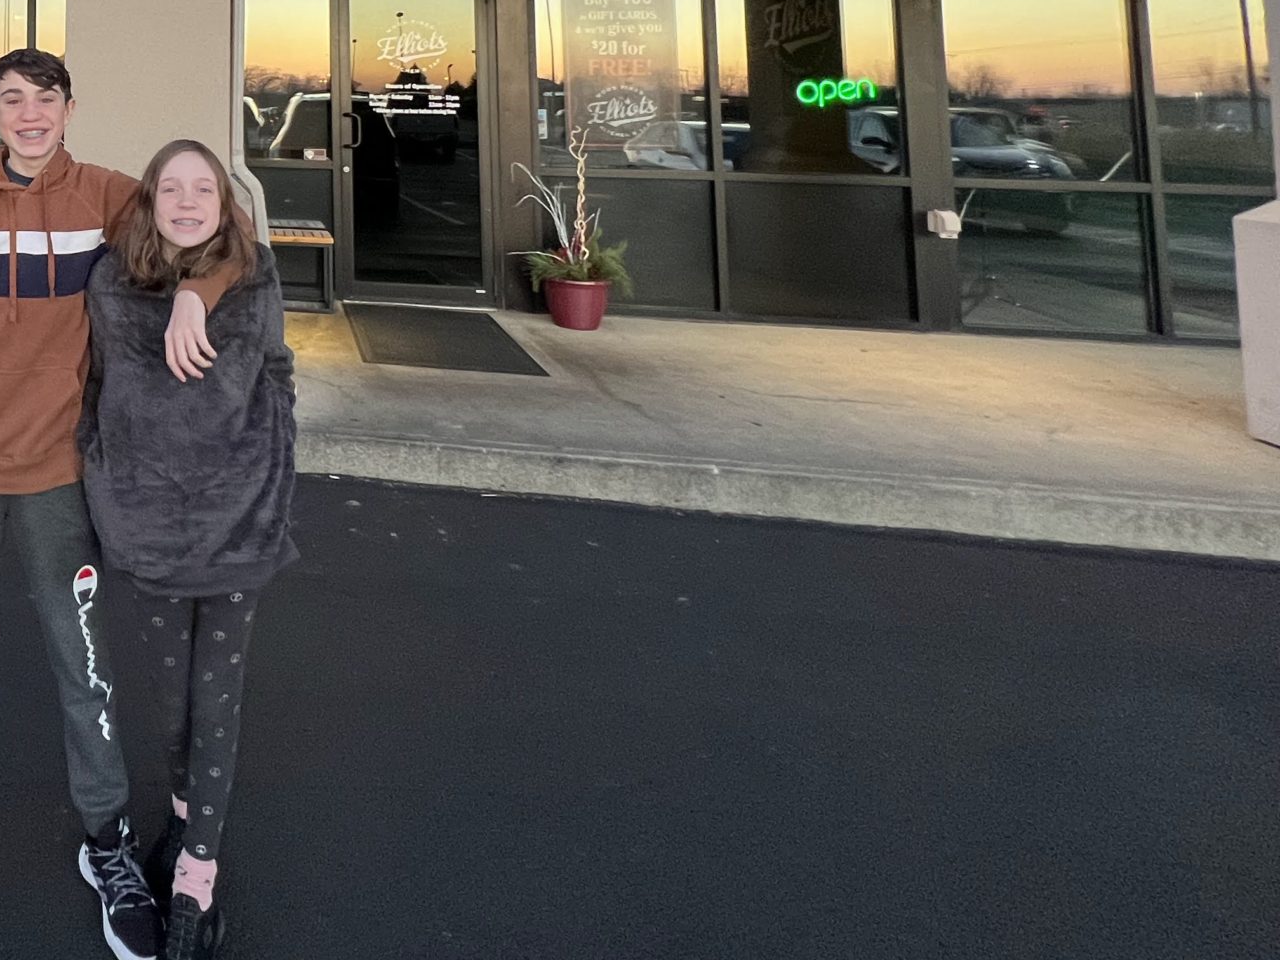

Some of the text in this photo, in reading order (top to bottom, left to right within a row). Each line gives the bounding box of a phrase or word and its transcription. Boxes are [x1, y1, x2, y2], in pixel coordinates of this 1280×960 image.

[588, 10, 614, 20] GIFT
[618, 9, 657, 20] CARDS
[607, 22, 636, 37] give
[639, 23, 662, 36] you
[592, 40, 647, 55] $20 for
[589, 58, 652, 76] FREE!
[796, 79, 876, 107] open
